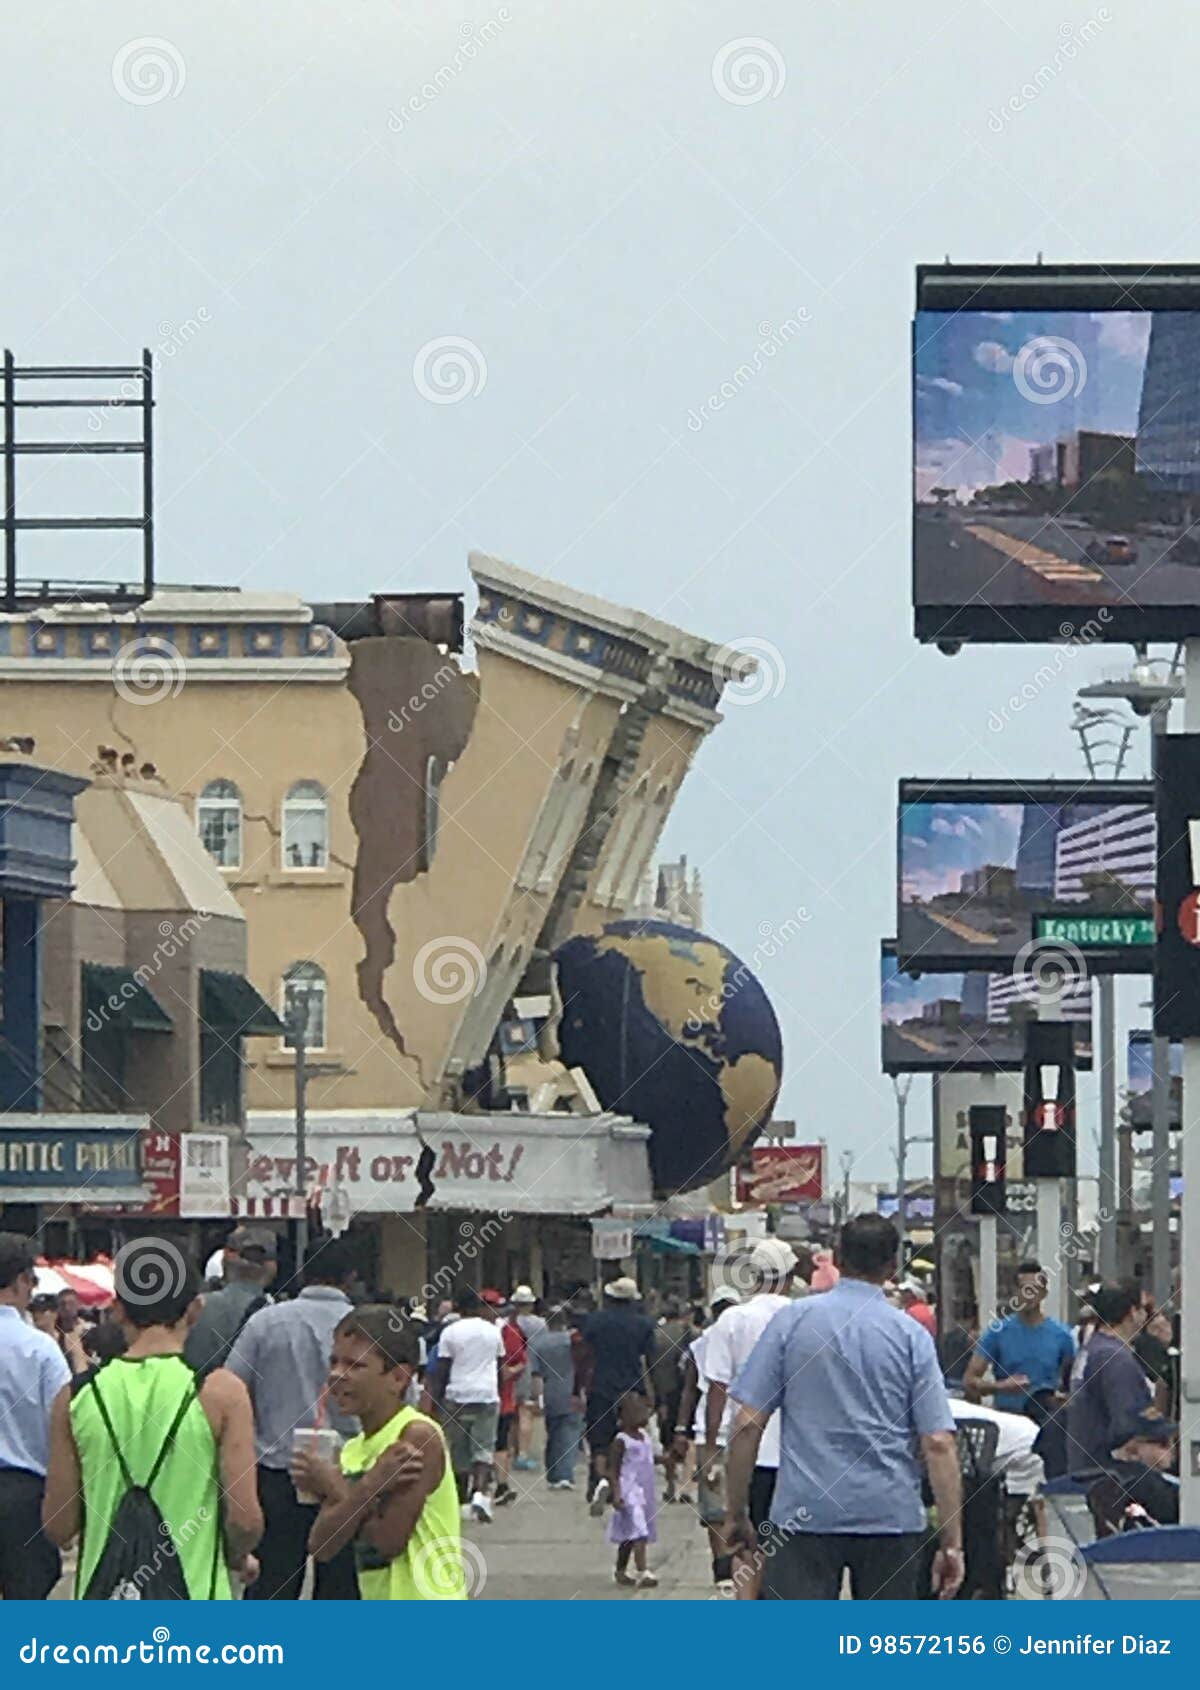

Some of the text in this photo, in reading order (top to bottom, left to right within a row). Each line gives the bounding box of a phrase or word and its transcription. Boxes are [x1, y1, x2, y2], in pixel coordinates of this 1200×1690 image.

[1044, 919, 1136, 944] Kentucky
[370, 1155, 414, 1182] or
[434, 1141, 524, 1182] Not!
